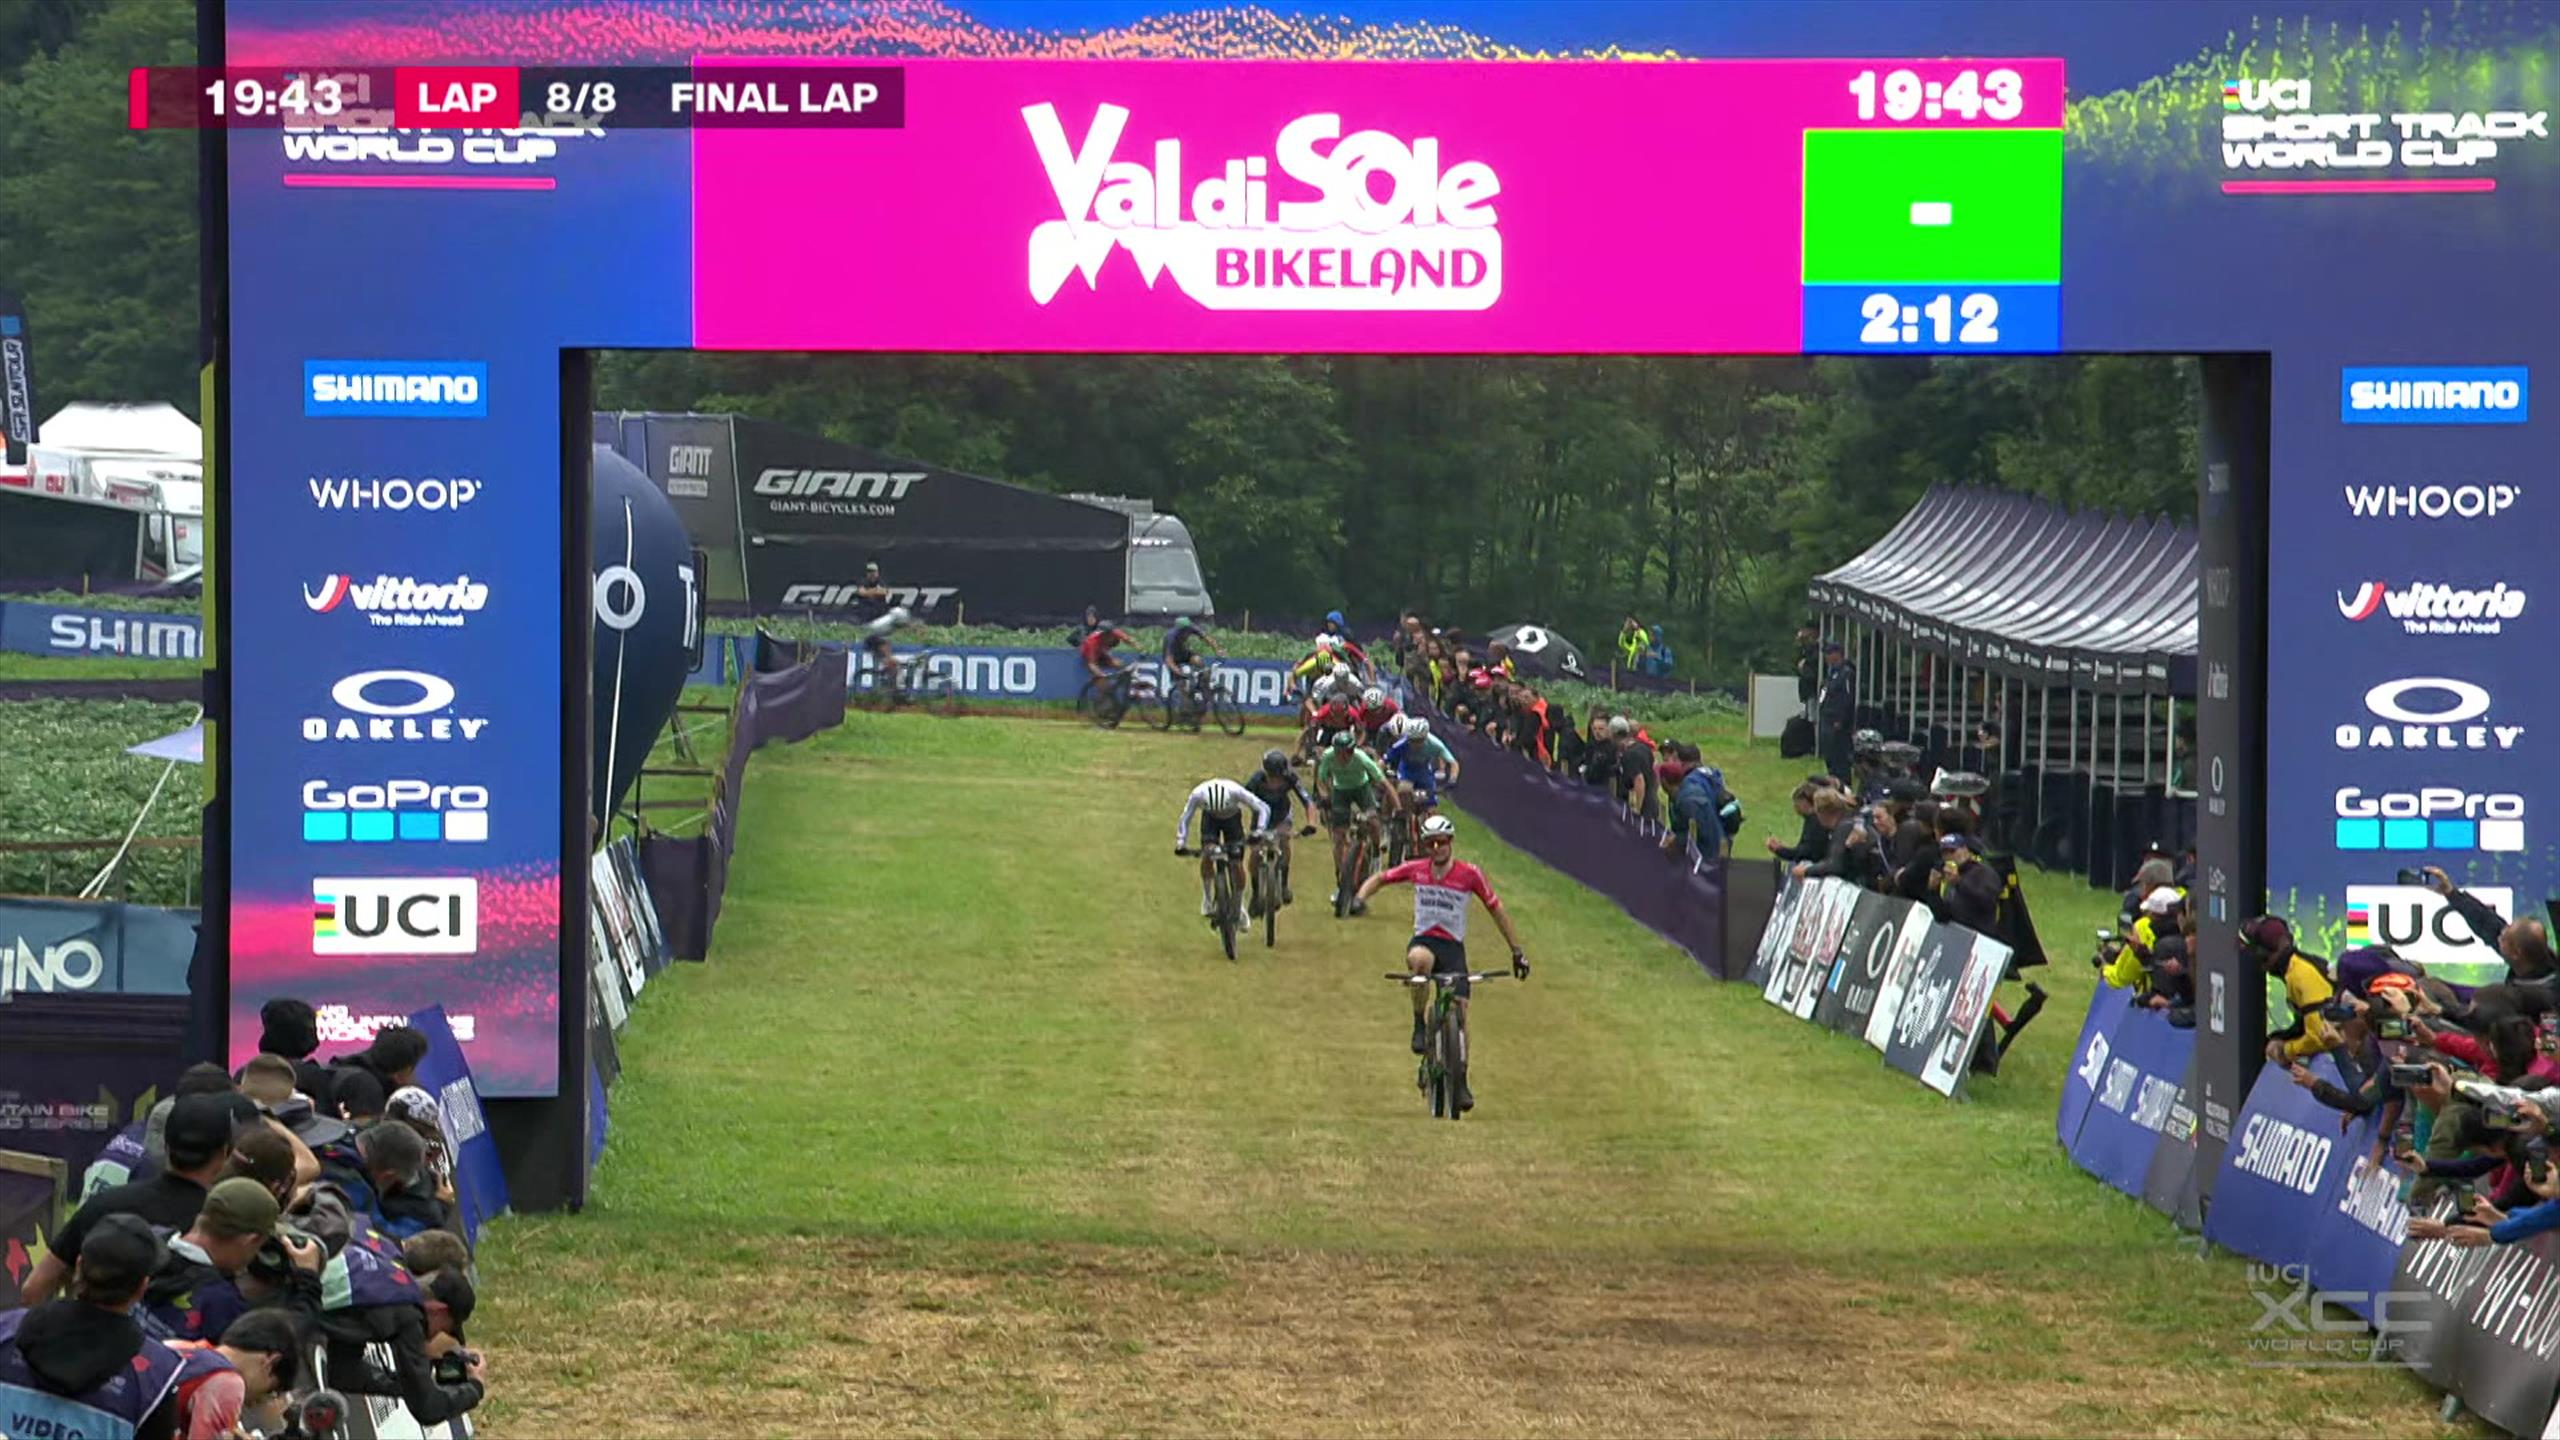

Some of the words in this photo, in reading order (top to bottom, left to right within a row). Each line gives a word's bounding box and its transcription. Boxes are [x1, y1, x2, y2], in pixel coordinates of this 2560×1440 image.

[1849, 68, 2023, 121] 19:43
[2239, 78, 2311, 112] UCI
[2222, 114, 2382, 140] SHORT
[2391, 112, 2549, 138] TRACK
[283, 135, 455, 162] WORLD
[462, 137, 557, 163] CUP
[2222, 140, 2393, 168] WORLD
[2401, 140, 2498, 166] CUP
[1021, 102, 1181, 234] Val
[1191, 155, 1268, 230] di
[1276, 112, 1501, 235] Sole
[1215, 247, 1488, 295] BIKELAND
[1860, 292, 1999, 343] 2:12
[312, 373, 479, 404] SHIMANO
[2350, 380, 2520, 410] SHIMANO
[669, 445, 713, 475] GIANT
[308, 477, 480, 510] WHOOP
[753, 469, 929, 499] GIANT
[2344, 484, 2517, 517] WHOOP
[349, 573, 489, 611] vittoria
[781, 584, 958, 608] GINT
[2383, 581, 2527, 619] vittoria
[50, 614, 203, 658] SHIM
[303, 718, 486, 741] OAKLEY
[2335, 725, 2520, 749] OAKLEY
[303, 779, 489, 810] GoPro
[2335, 786, 2525, 818] GoPro
[345, 895, 461, 938] UCI
[2378, 903, 2497, 947] UC
[0, 936, 103, 1003] INO
[2233, 1112, 2332, 1195] SHIMANO
